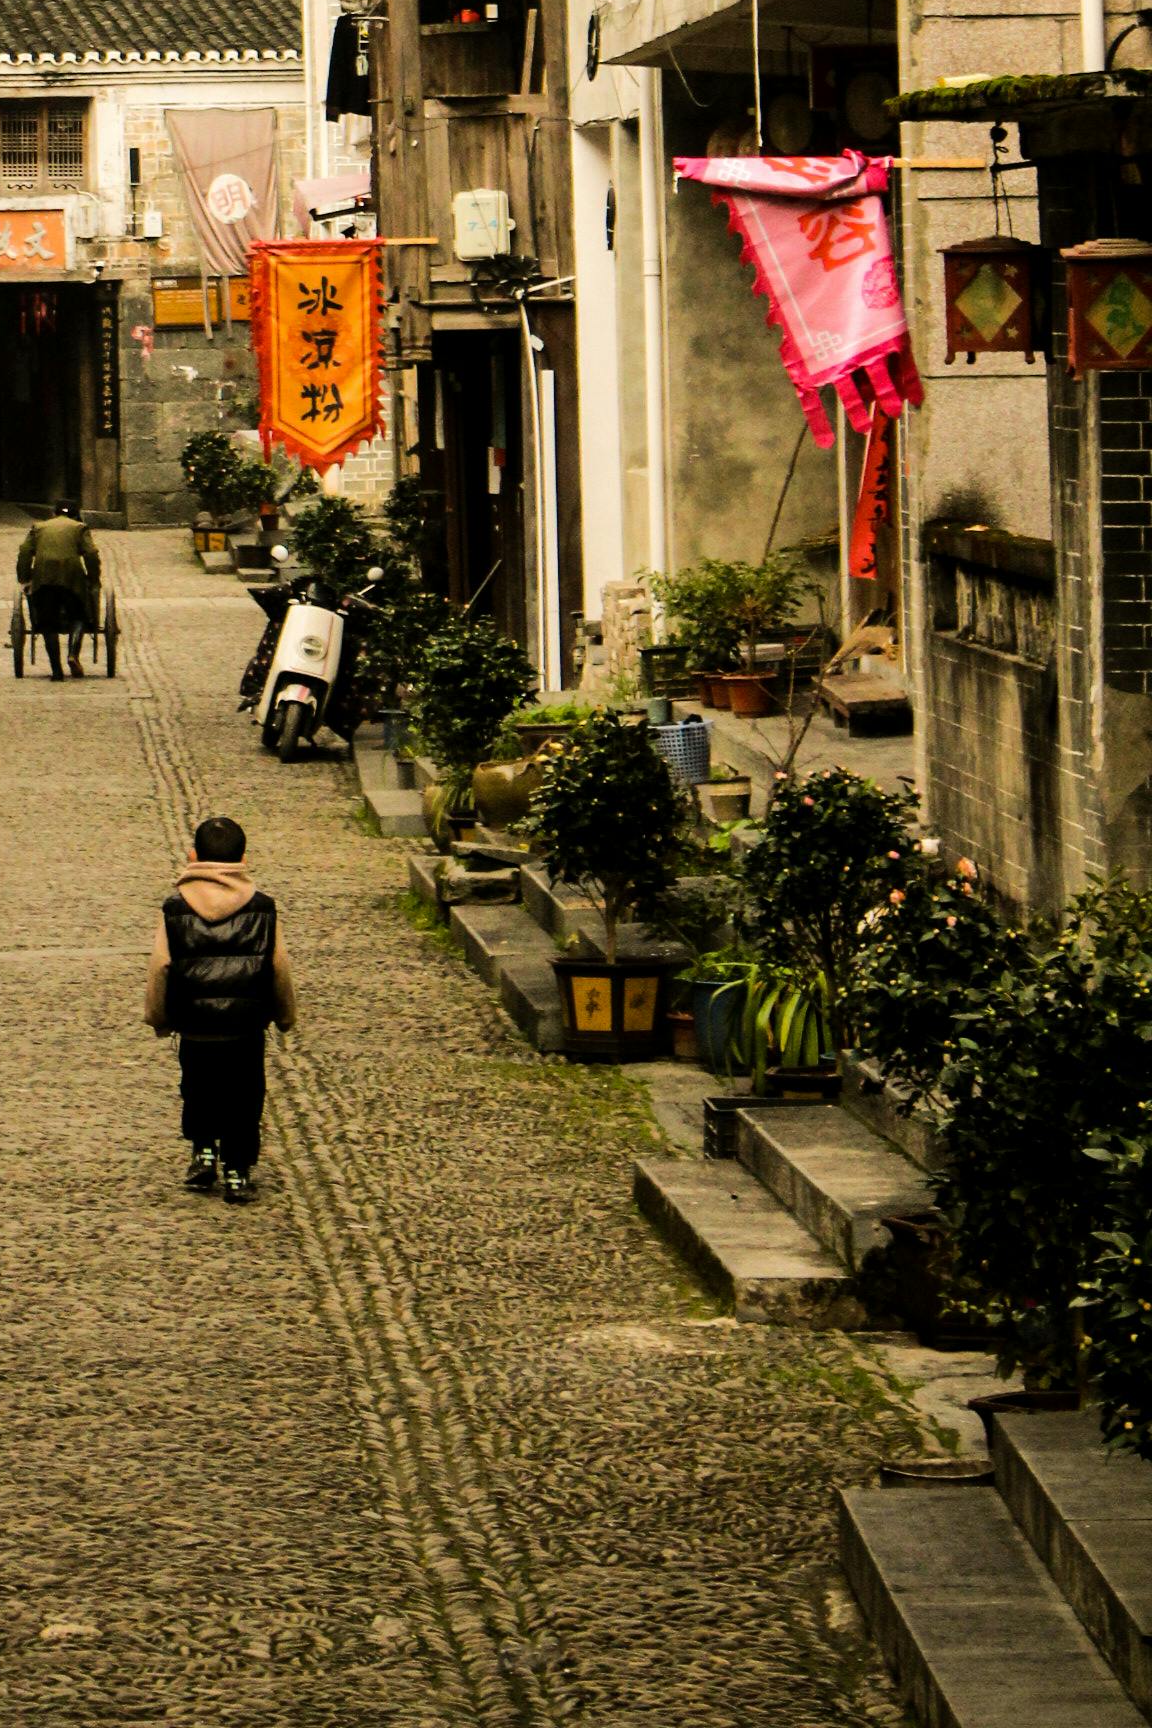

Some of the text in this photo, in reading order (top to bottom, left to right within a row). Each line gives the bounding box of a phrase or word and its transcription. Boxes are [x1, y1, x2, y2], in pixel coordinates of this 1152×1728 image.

[211, 181, 246, 215] 明
[297, 276, 344, 423] 冰凉粉
